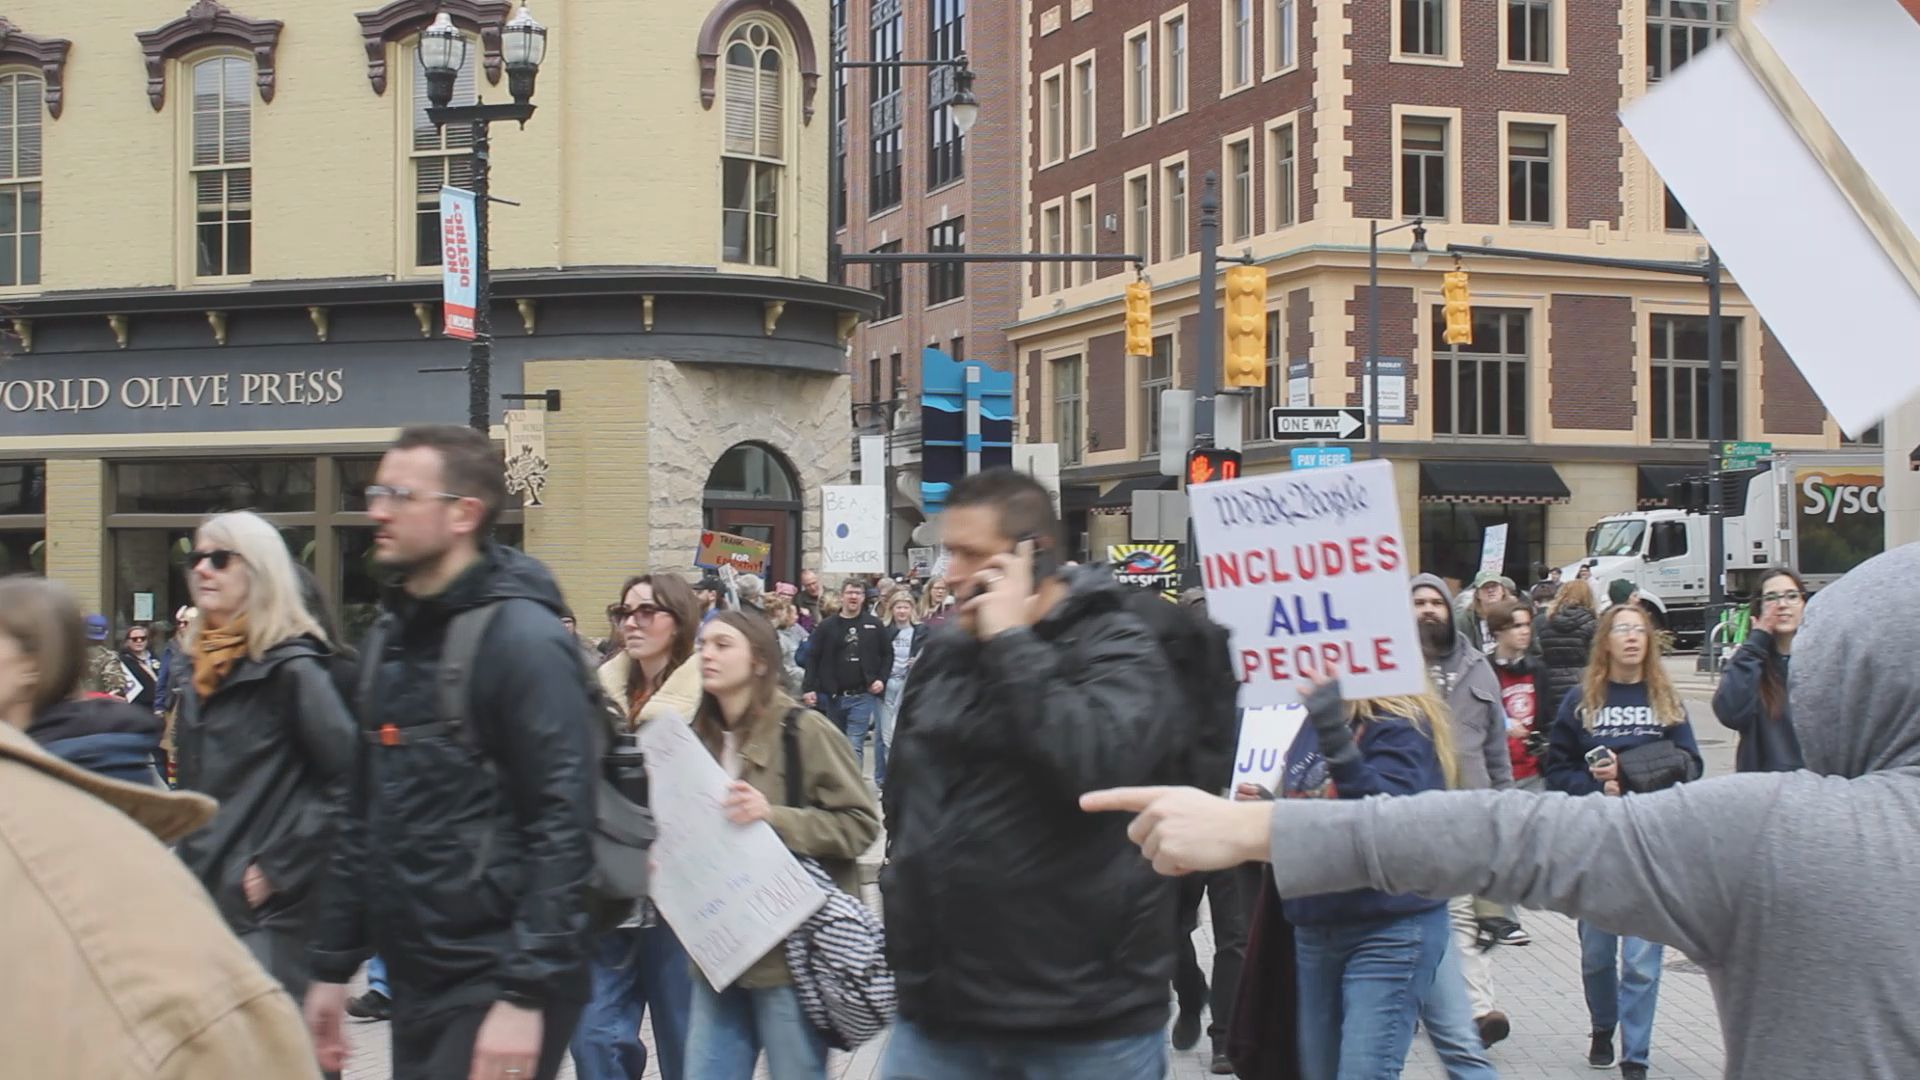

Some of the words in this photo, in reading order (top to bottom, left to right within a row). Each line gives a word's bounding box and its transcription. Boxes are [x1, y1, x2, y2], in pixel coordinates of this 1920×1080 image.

[445, 217, 457, 274] HOTEL
[453, 202, 470, 289] DISTRICT
[121, 371, 230, 410] OLIVE
[239, 368, 344, 406] PRESS
[1281, 418, 1309, 431] ONE
[1313, 418, 1340, 431] WAY
[1297, 454, 1316, 466] PAY
[1319, 453, 1345, 466] HERE
[826, 491, 846, 512] BE
[731, 552, 750, 563] FOR
[1203, 535, 1401, 590] INCLUDES
[1267, 591, 1348, 637] ALL
[1239, 636, 1398, 684] PEOPLE
[1593, 705, 1667, 728] DISSEN
[1238, 748, 1285, 774] JU
